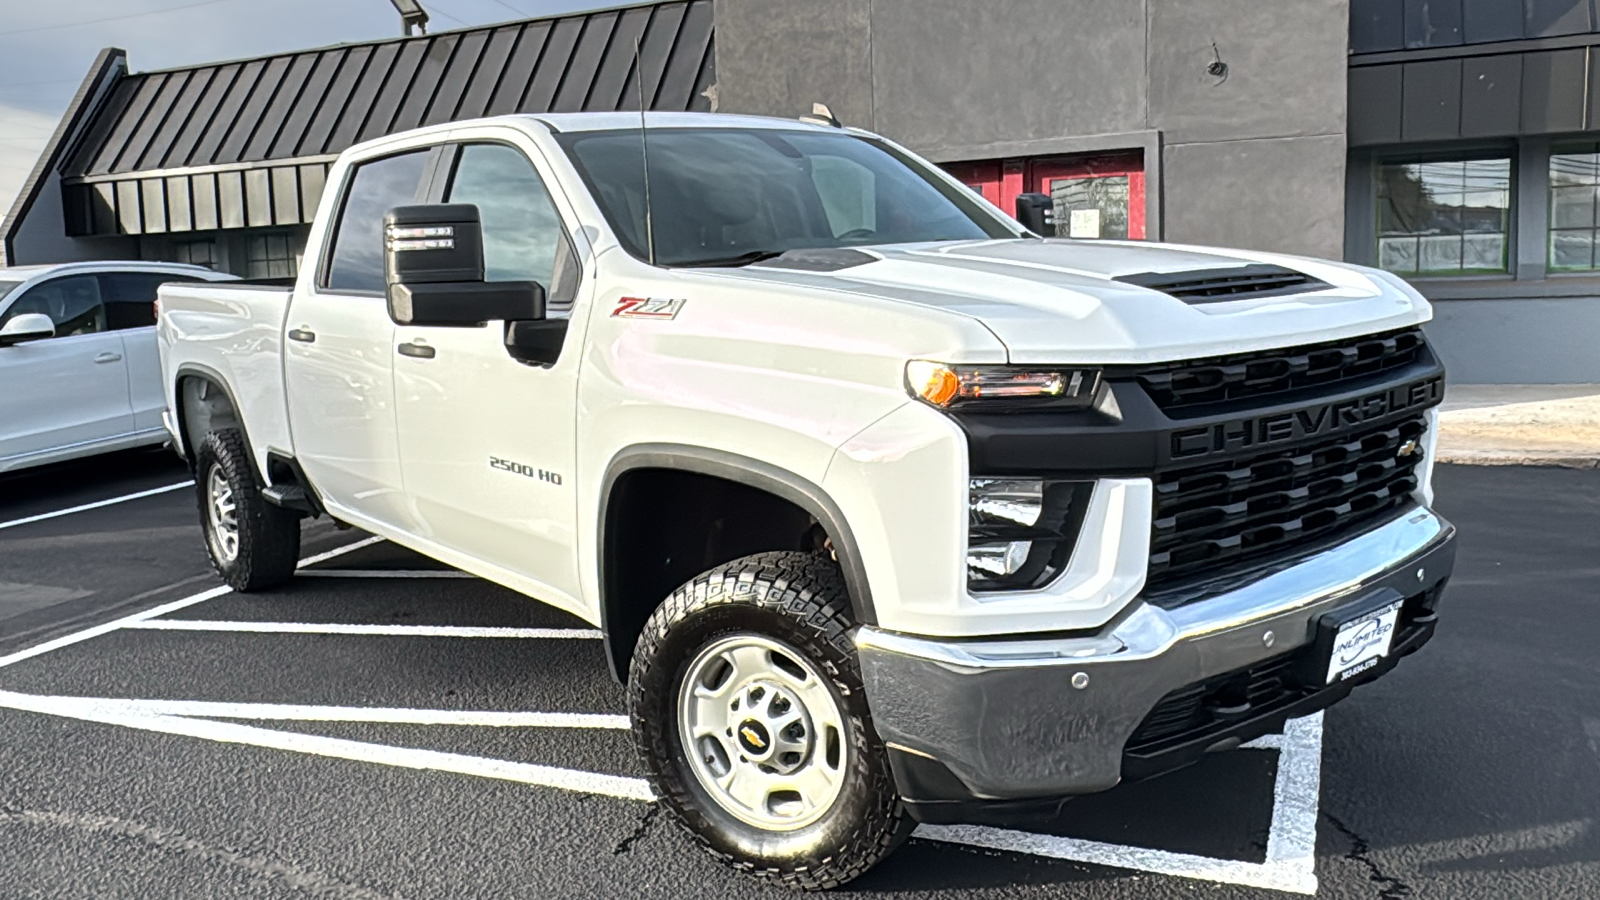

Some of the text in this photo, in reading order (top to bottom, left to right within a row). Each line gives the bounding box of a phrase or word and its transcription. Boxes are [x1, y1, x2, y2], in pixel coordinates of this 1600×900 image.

[609, 296, 687, 321] Z71
[1170, 375, 1442, 460] CHEVROLET
[489, 456, 562, 486] 2500 HD
[1332, 622, 1393, 656] UNLIMITED
